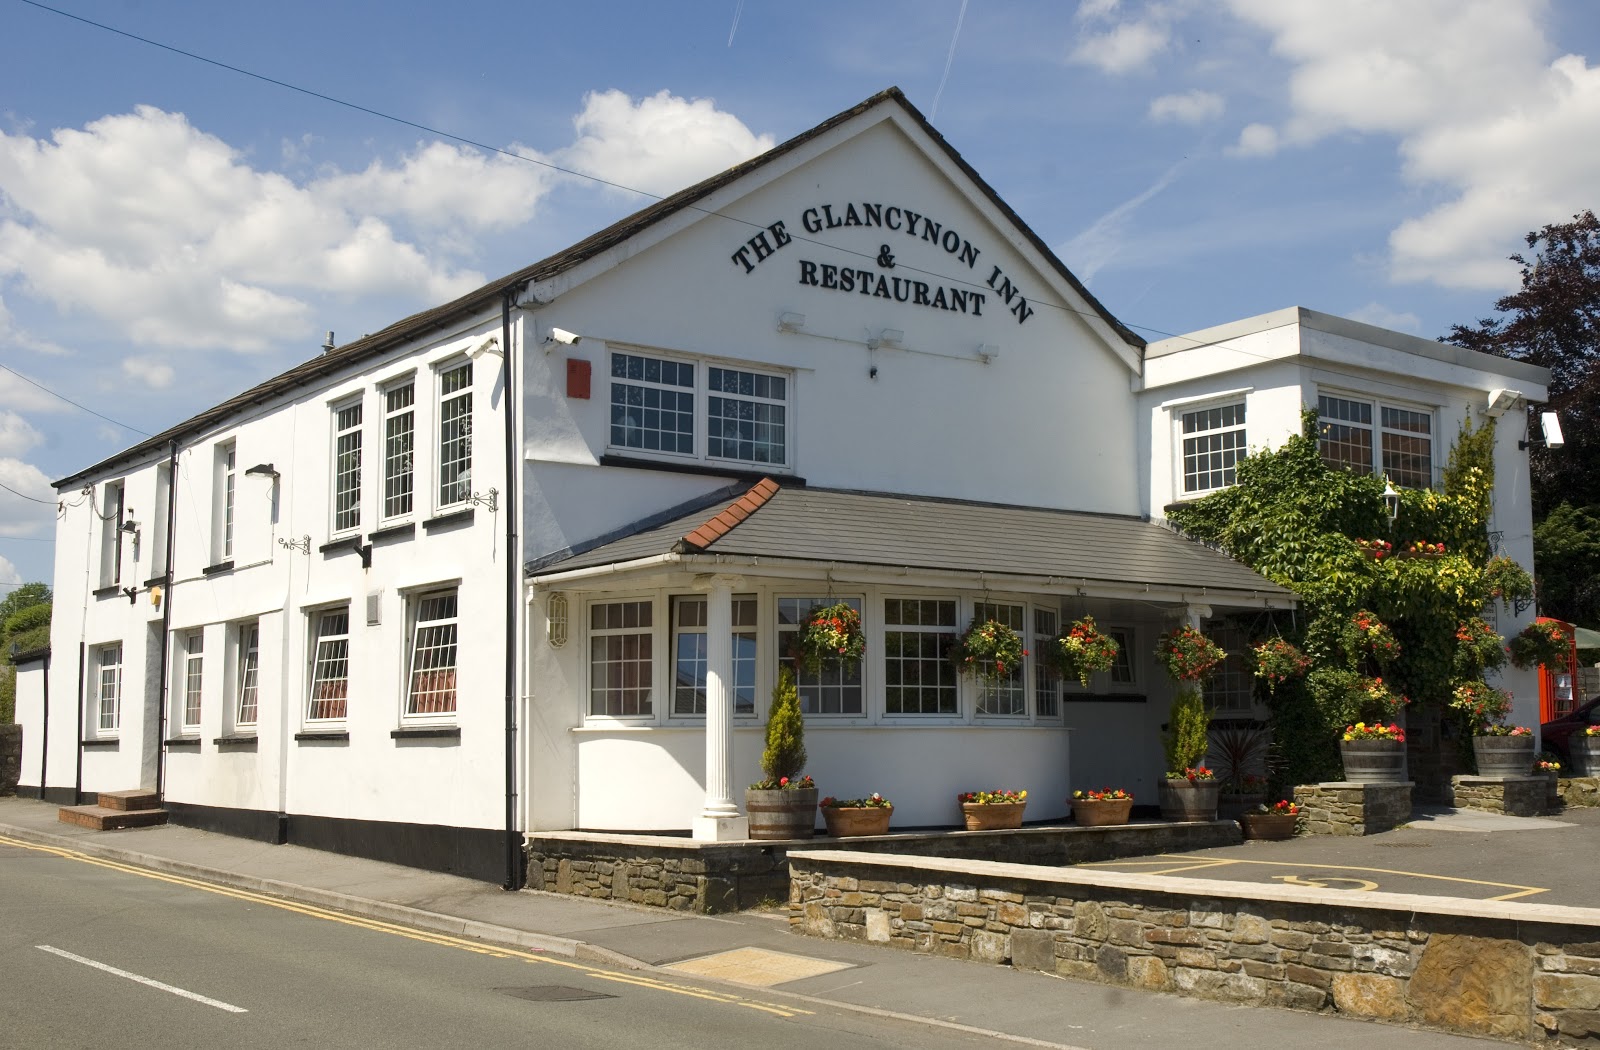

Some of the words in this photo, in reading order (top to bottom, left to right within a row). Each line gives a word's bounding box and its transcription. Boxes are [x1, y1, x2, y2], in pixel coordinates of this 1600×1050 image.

[730, 220, 793, 275] THE
[801, 202, 981, 269] GLANCYNON
[986, 265, 1034, 325] INN
[876, 243, 897, 270] &
[798, 259, 986, 317] RESTAURANT
